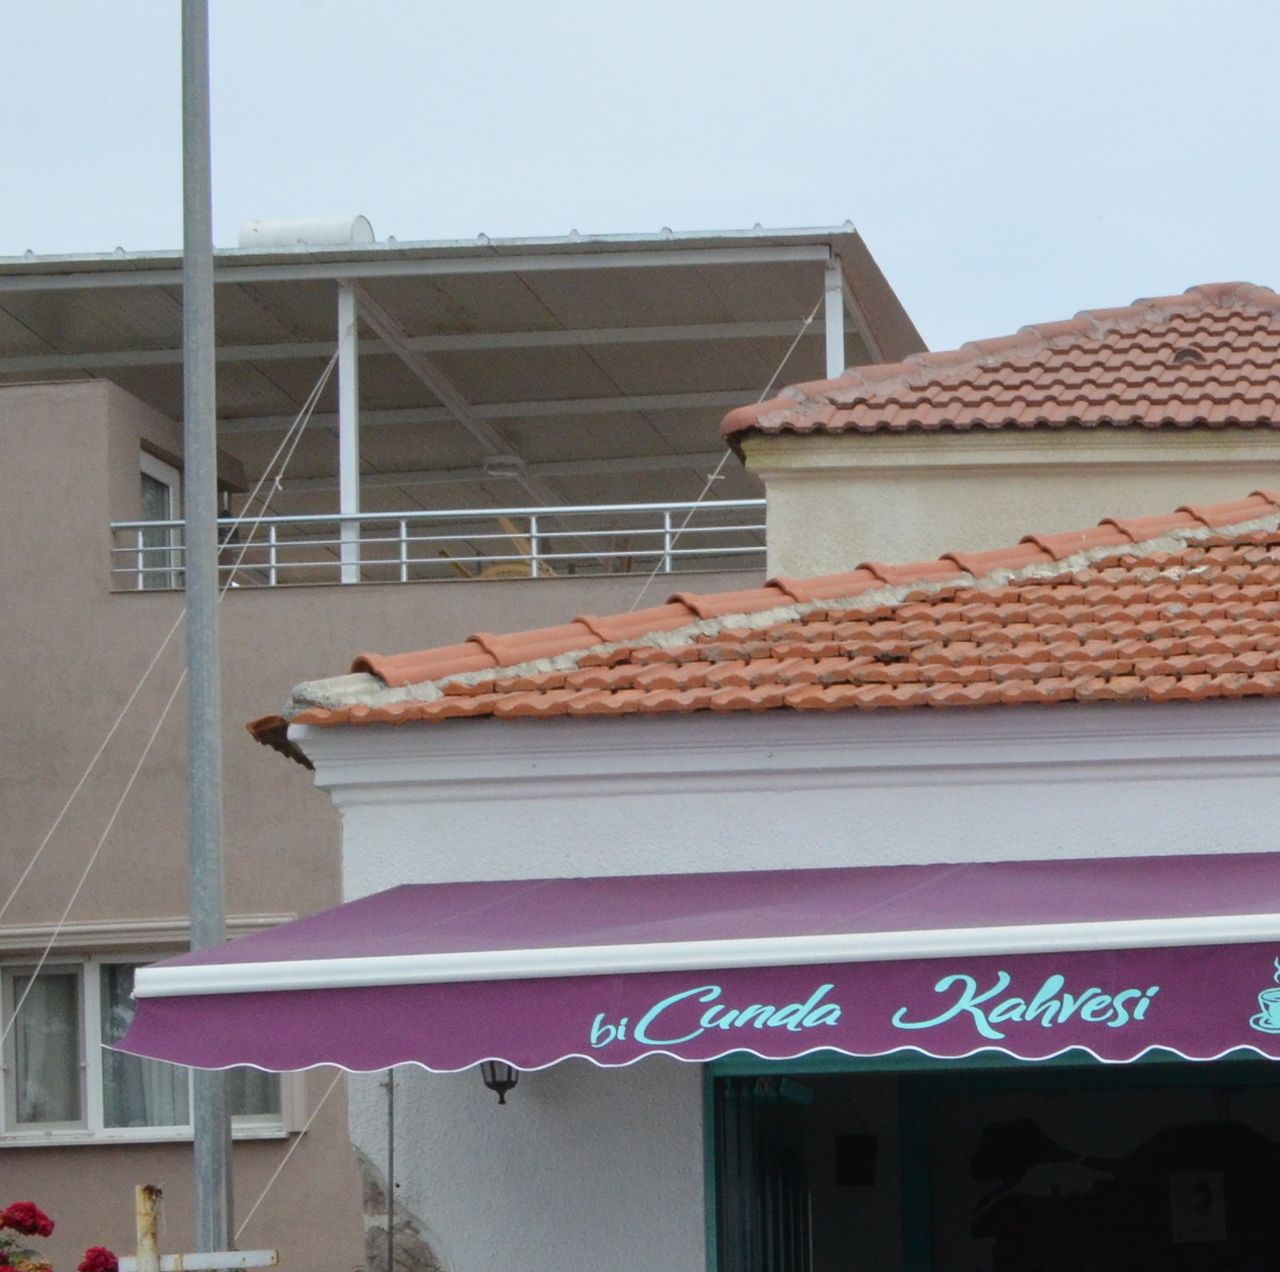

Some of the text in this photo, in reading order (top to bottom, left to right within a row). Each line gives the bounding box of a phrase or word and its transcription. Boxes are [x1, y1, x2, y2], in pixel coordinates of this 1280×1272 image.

[590, 971, 1160, 1048] bi Cunda Kahvesi
